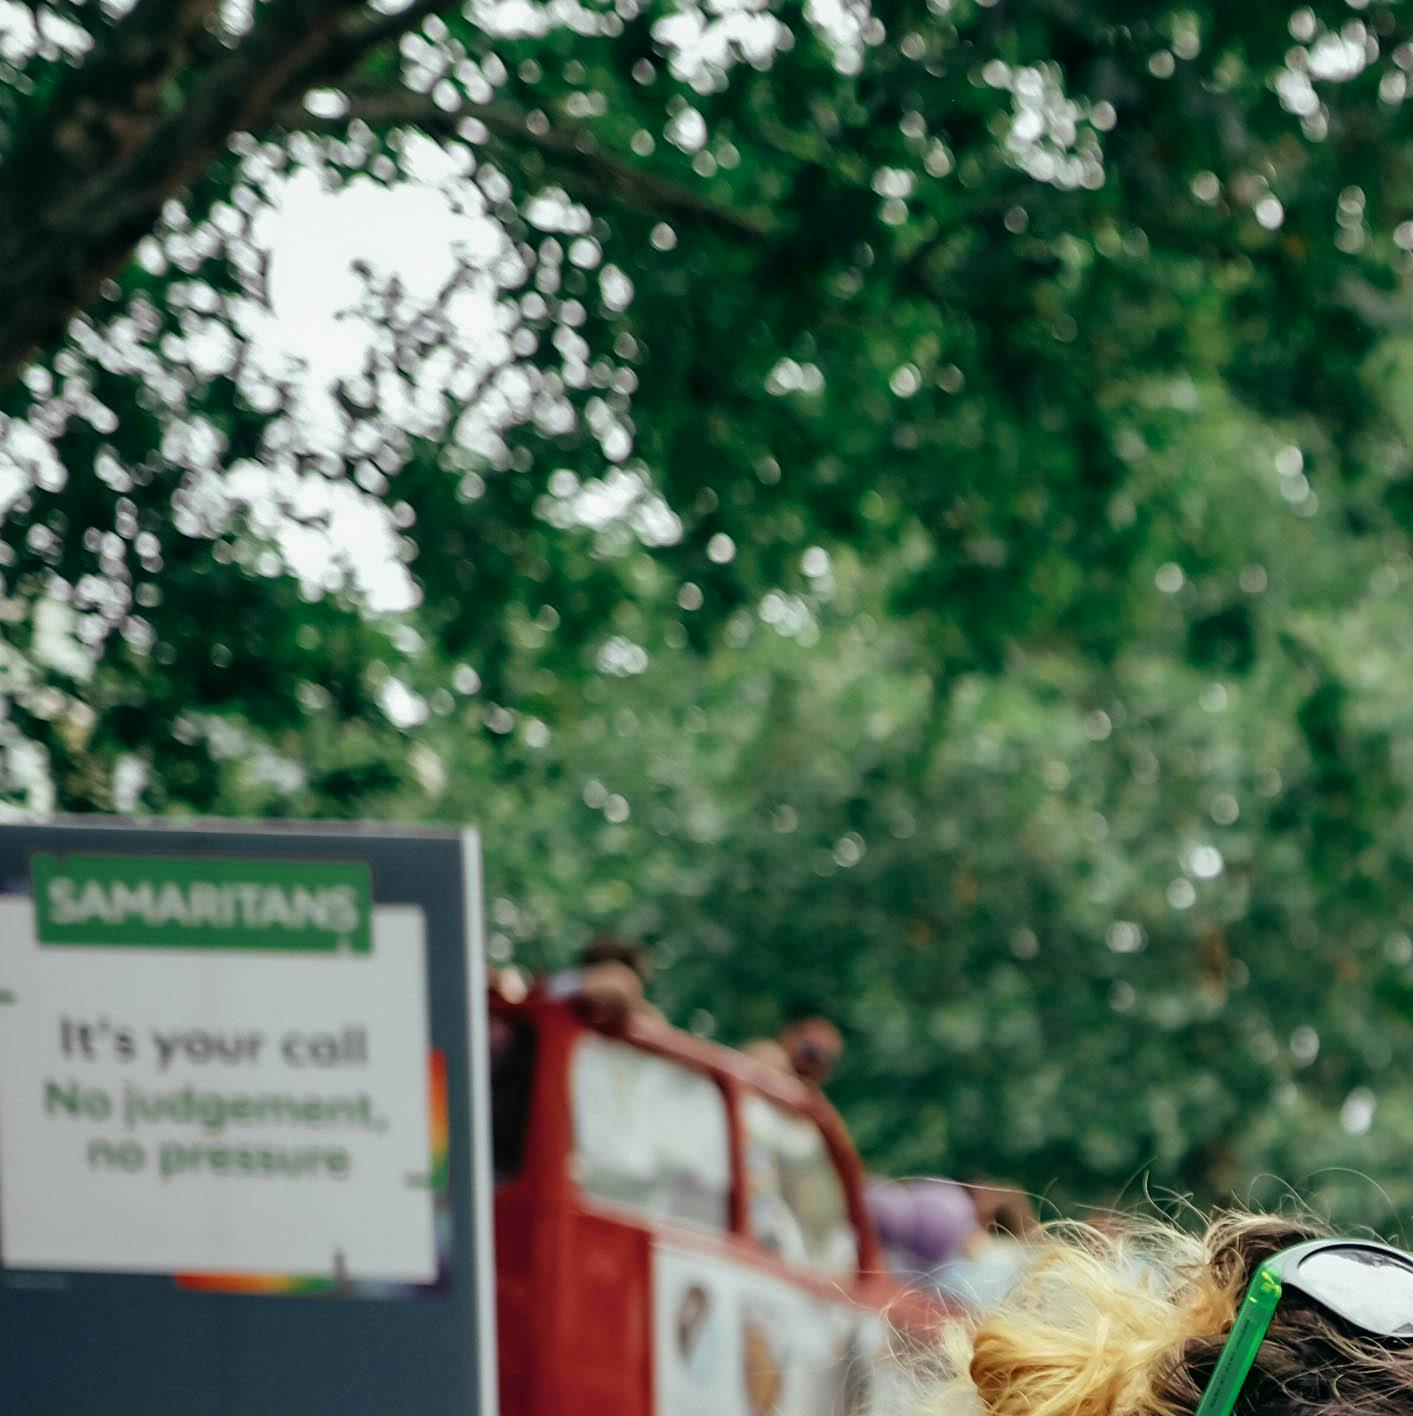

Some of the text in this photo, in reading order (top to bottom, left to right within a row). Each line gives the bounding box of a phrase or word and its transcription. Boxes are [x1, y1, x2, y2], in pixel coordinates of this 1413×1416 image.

[47, 877, 359, 934] SAMARITANS
[59, 1018, 369, 1071] It's your call
[43, 1079, 390, 1136] No judgement,
[87, 1138, 351, 1182] no pressure
